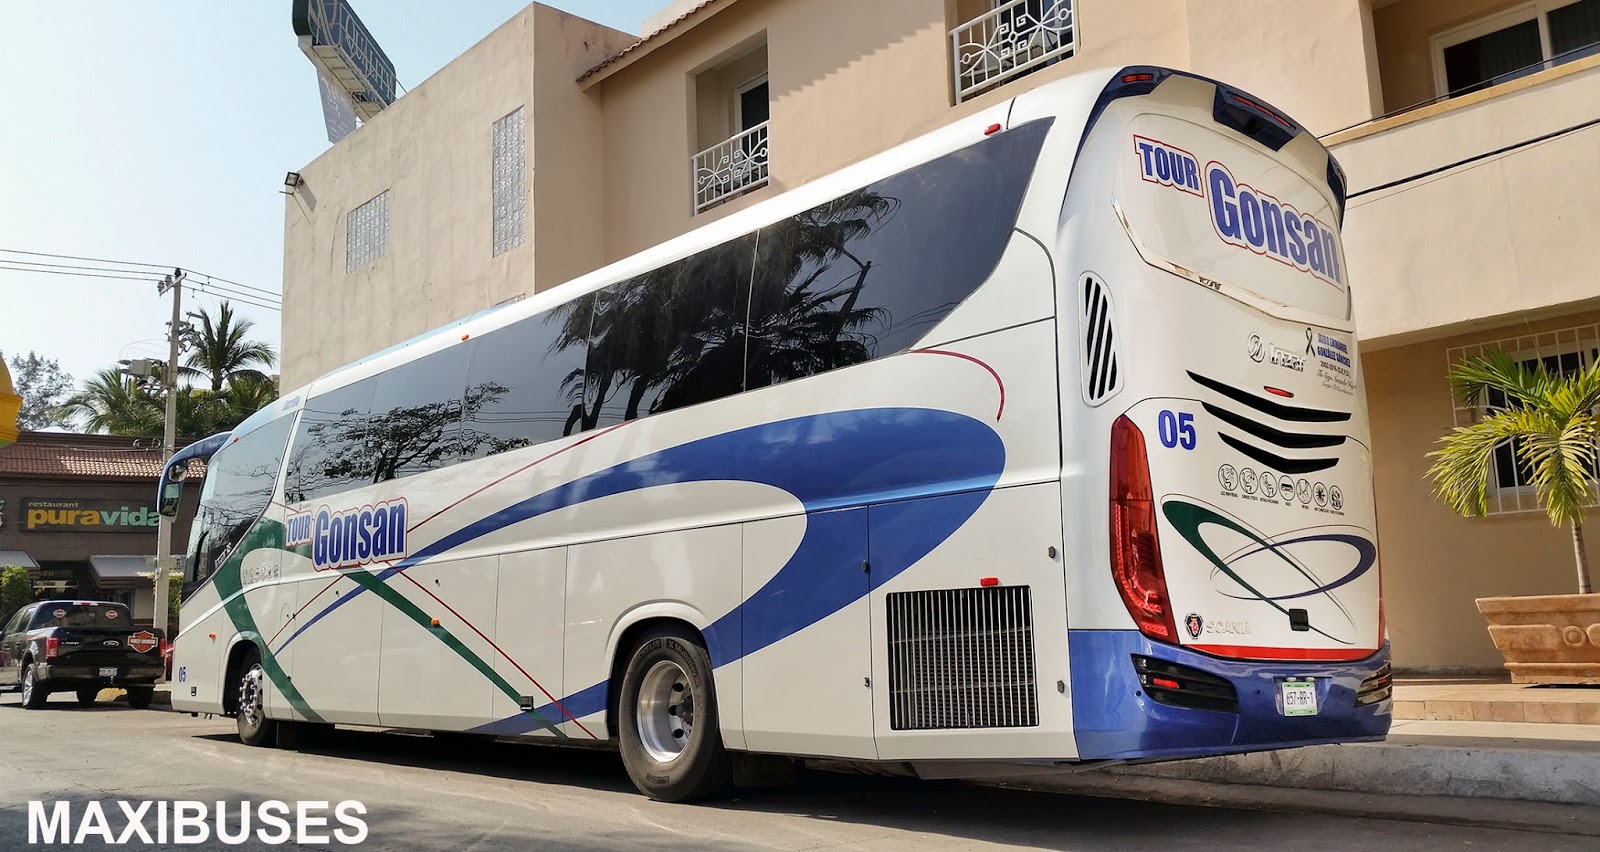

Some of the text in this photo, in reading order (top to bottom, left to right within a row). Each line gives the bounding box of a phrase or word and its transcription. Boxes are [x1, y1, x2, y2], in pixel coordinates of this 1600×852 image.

[1139, 142, 1342, 285] TOUR Gonsan
[1158, 409, 1197, 451] 05
[286, 503, 406, 565] TOUR Gonsan
[178, 666, 186, 683] 05
